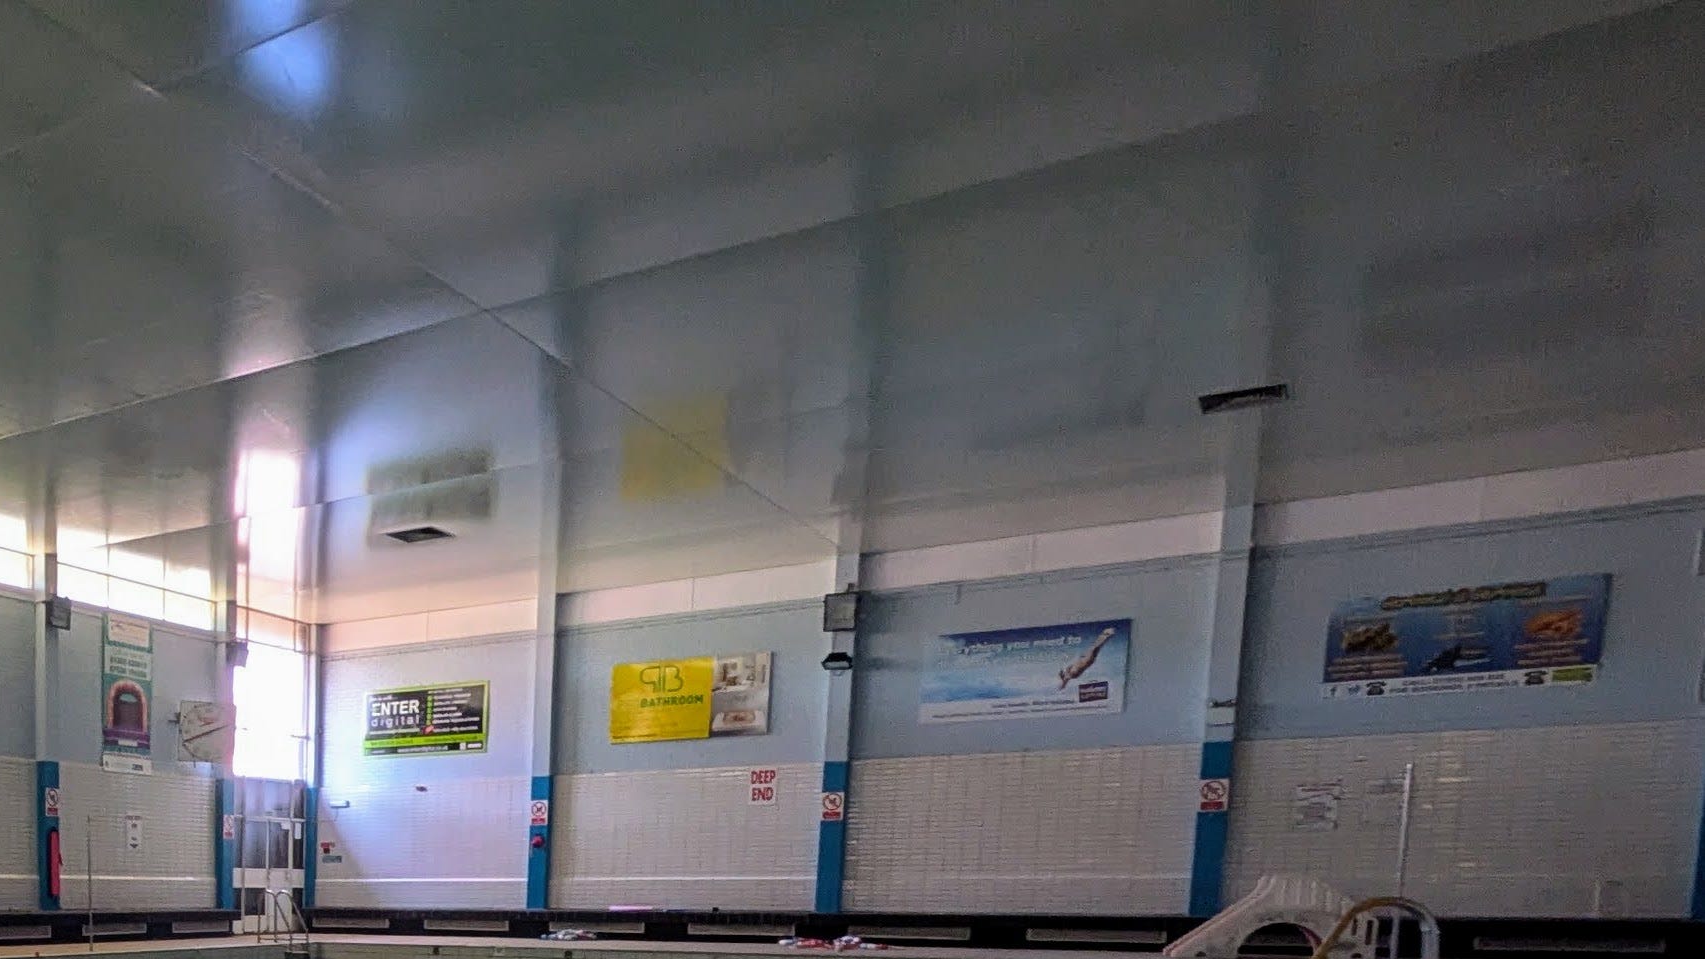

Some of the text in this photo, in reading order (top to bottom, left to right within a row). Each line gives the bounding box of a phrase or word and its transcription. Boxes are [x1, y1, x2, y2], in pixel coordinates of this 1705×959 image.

[371, 700, 420, 717] ENTER
[640, 695, 704, 708] BATHROOM
[371, 715, 420, 728] digital
[750, 769, 776, 785] DEEP
[751, 787, 774, 801] END
